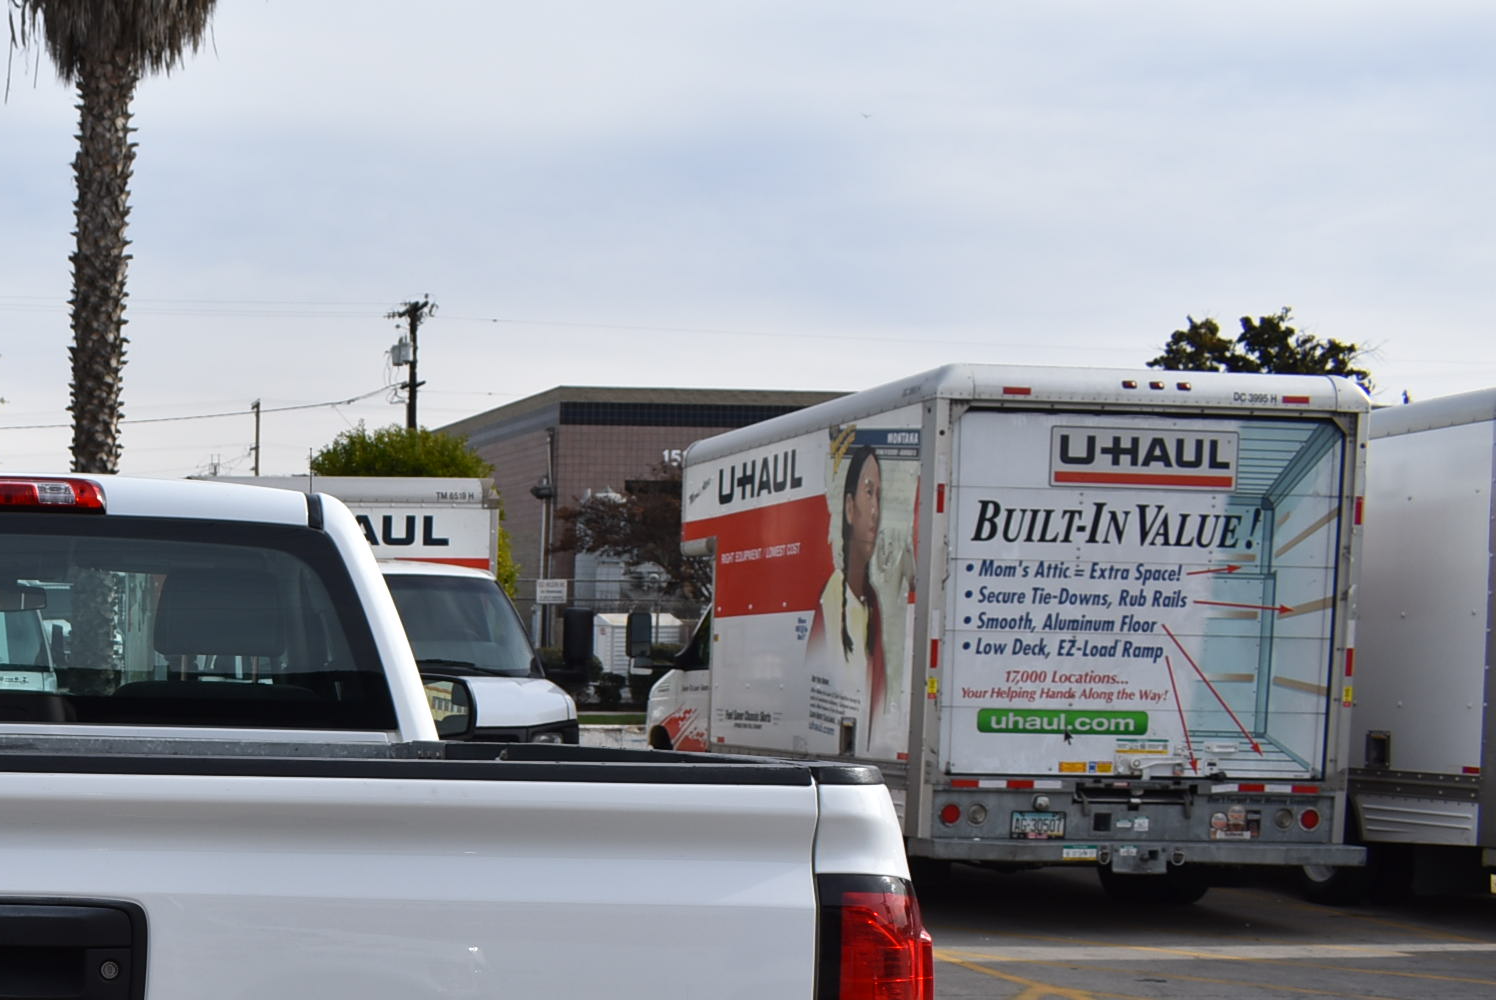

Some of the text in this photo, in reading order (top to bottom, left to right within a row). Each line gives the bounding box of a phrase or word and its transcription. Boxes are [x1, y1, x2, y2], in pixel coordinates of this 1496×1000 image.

[1233, 391, 1247, 402] DC
[1059, 434, 1231, 470] U-HAUL
[718, 449, 803, 505] U-HAUL
[978, 559, 1029, 578] Mom's
[1034, 560, 1071, 579] Attic
[1089, 562, 1130, 581] Extra
[1134, 563, 1183, 586] Space!
[977, 586, 1188, 609] Secure Tie-Downs, Rub Rails
[976, 612, 1157, 633] Smooth, Aluminum Floor
[975, 637, 1007, 656] Low
[1012, 638, 1051, 659] Deck,
[1121, 640, 1164, 663] Ramp
[1004, 670, 1047, 686] 17,000
[961, 687, 1169, 705] Your Helping Hands Along the Way!
[990, 712, 1136, 732] uhaul.com
